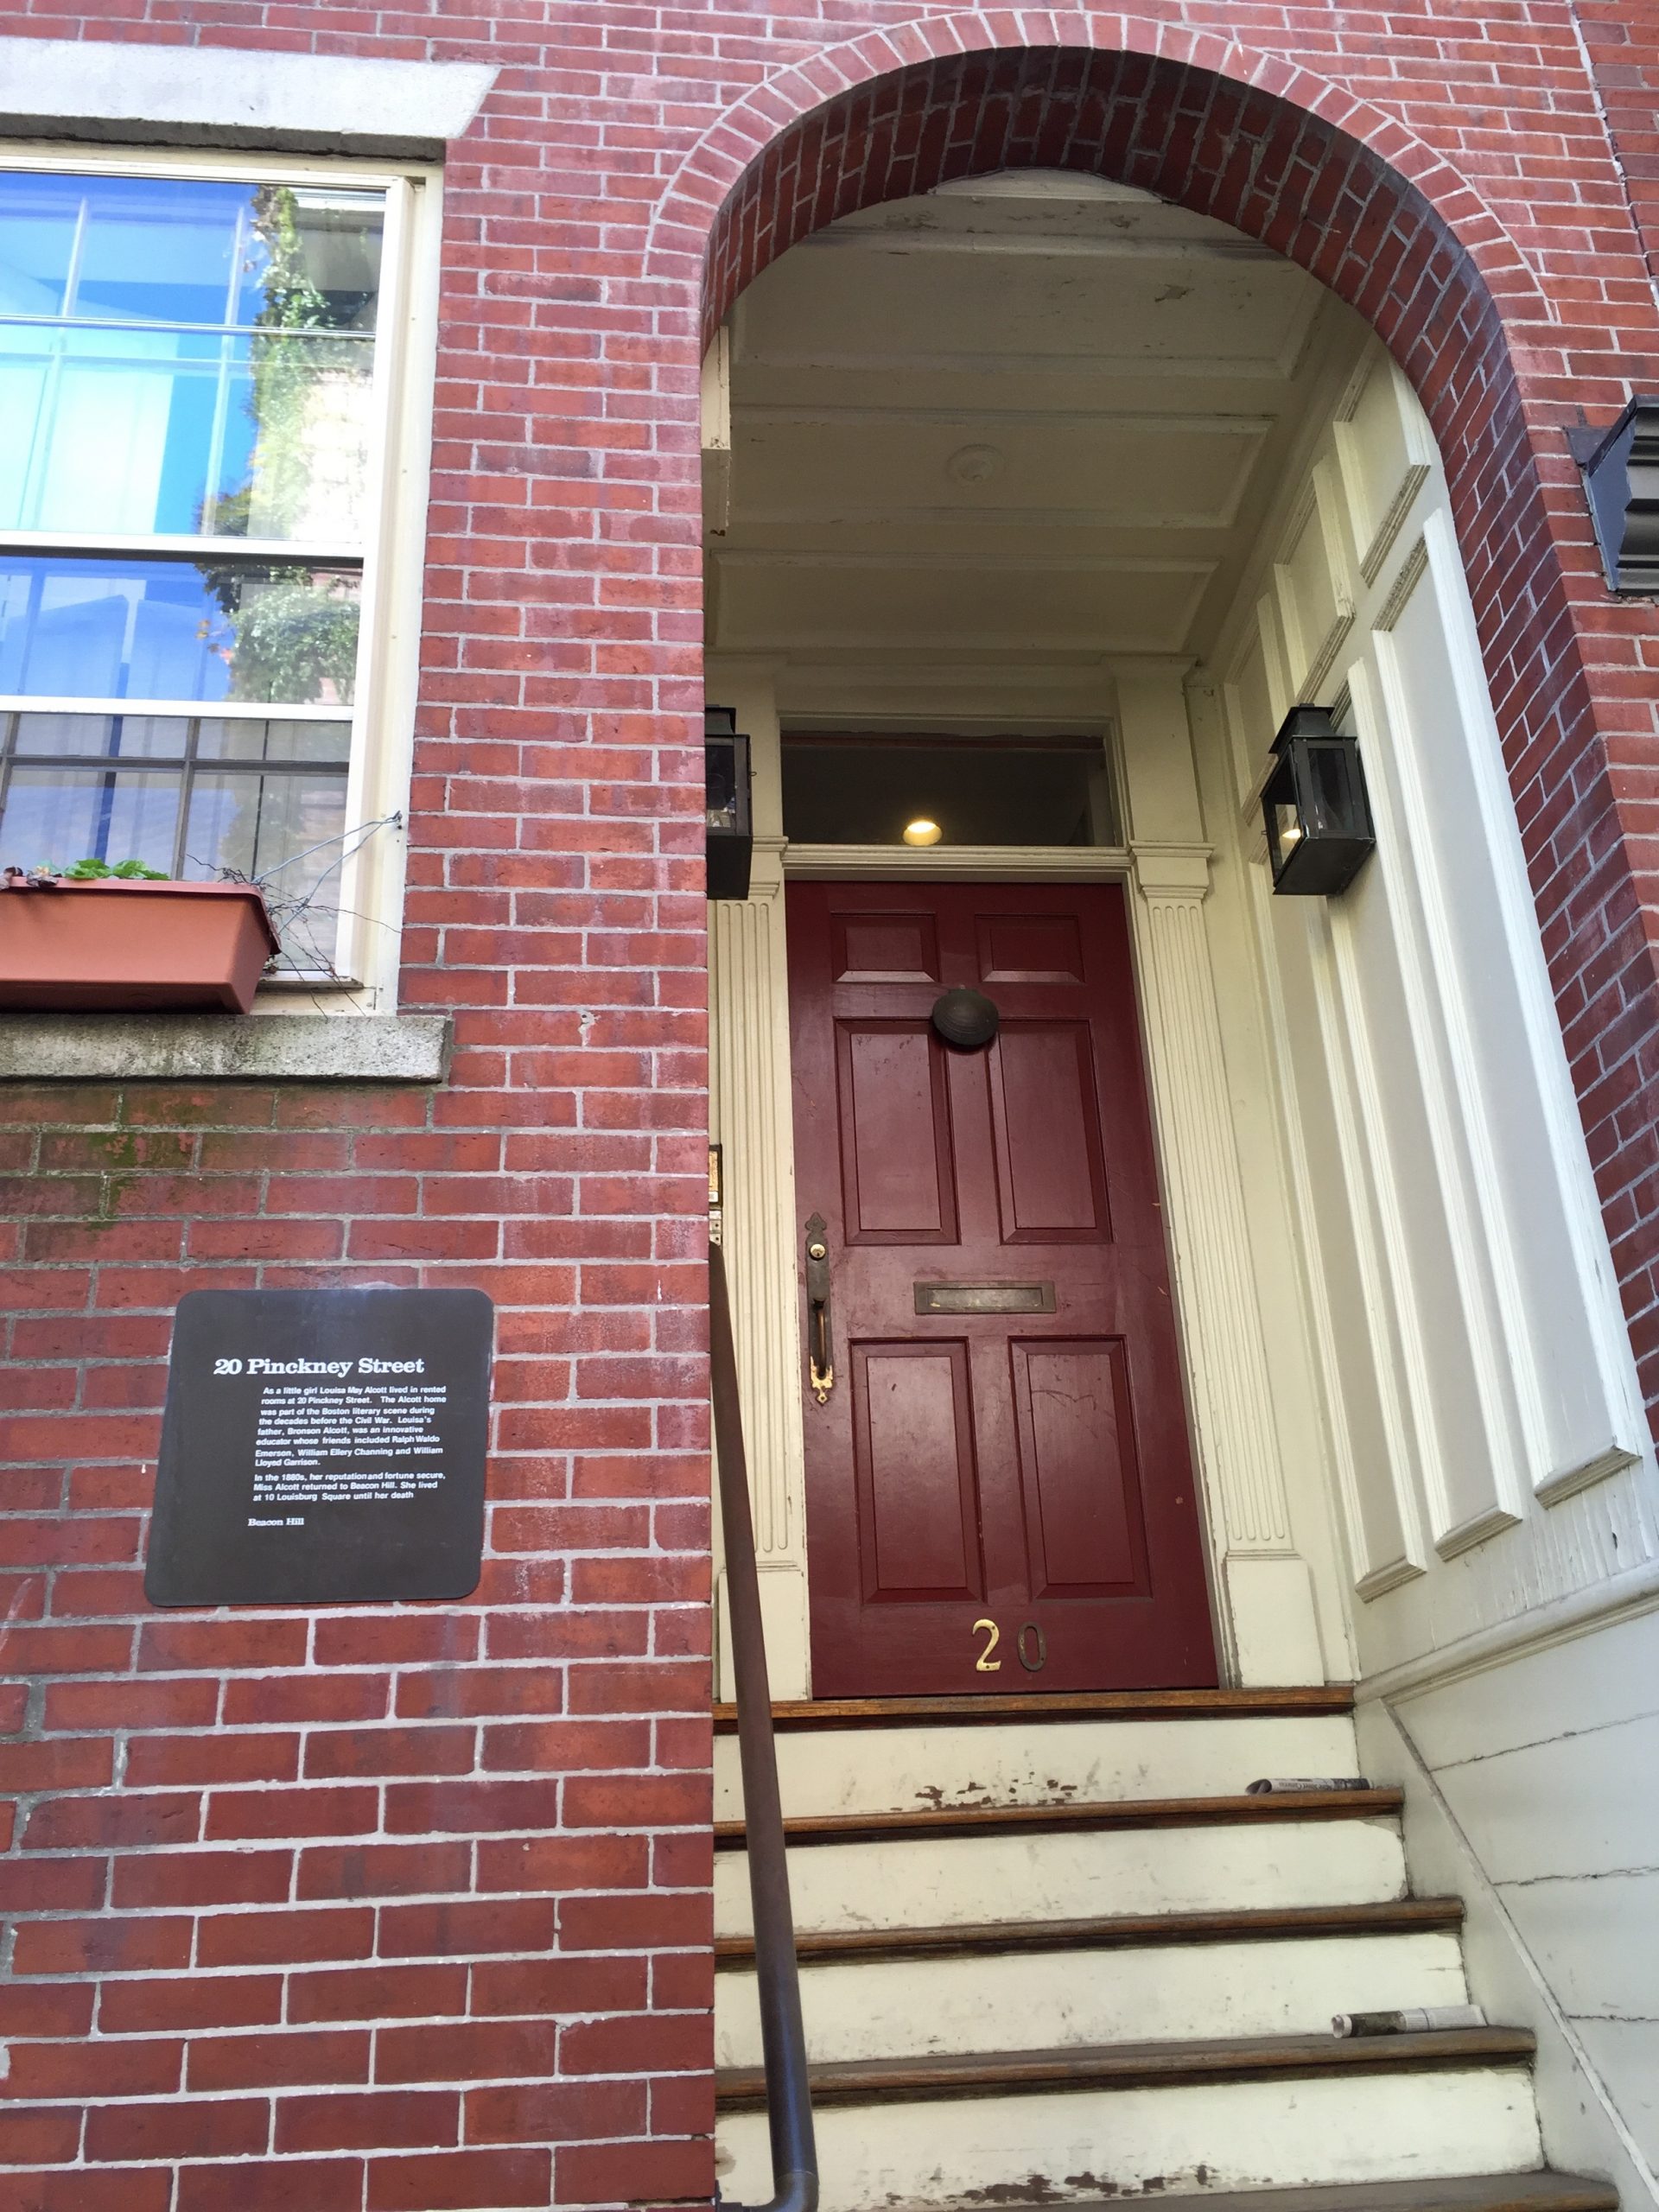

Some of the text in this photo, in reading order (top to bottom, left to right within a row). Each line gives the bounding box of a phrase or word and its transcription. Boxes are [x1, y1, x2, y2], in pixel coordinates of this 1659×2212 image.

[213, 1357, 424, 1378] 20 Pinckney Street
[304, 1387, 318, 1395] girl
[410, 1407, 435, 1415] during
[330, 1448, 353, 1457] Ellery
[354, 1448, 393, 1457] Channing
[326, 1473, 367, 1482] reputation
[276, 1493, 317, 1502] Louisburg
[322, 1492, 351, 1502] Square
[972, 1618, 1046, 1672] 20
